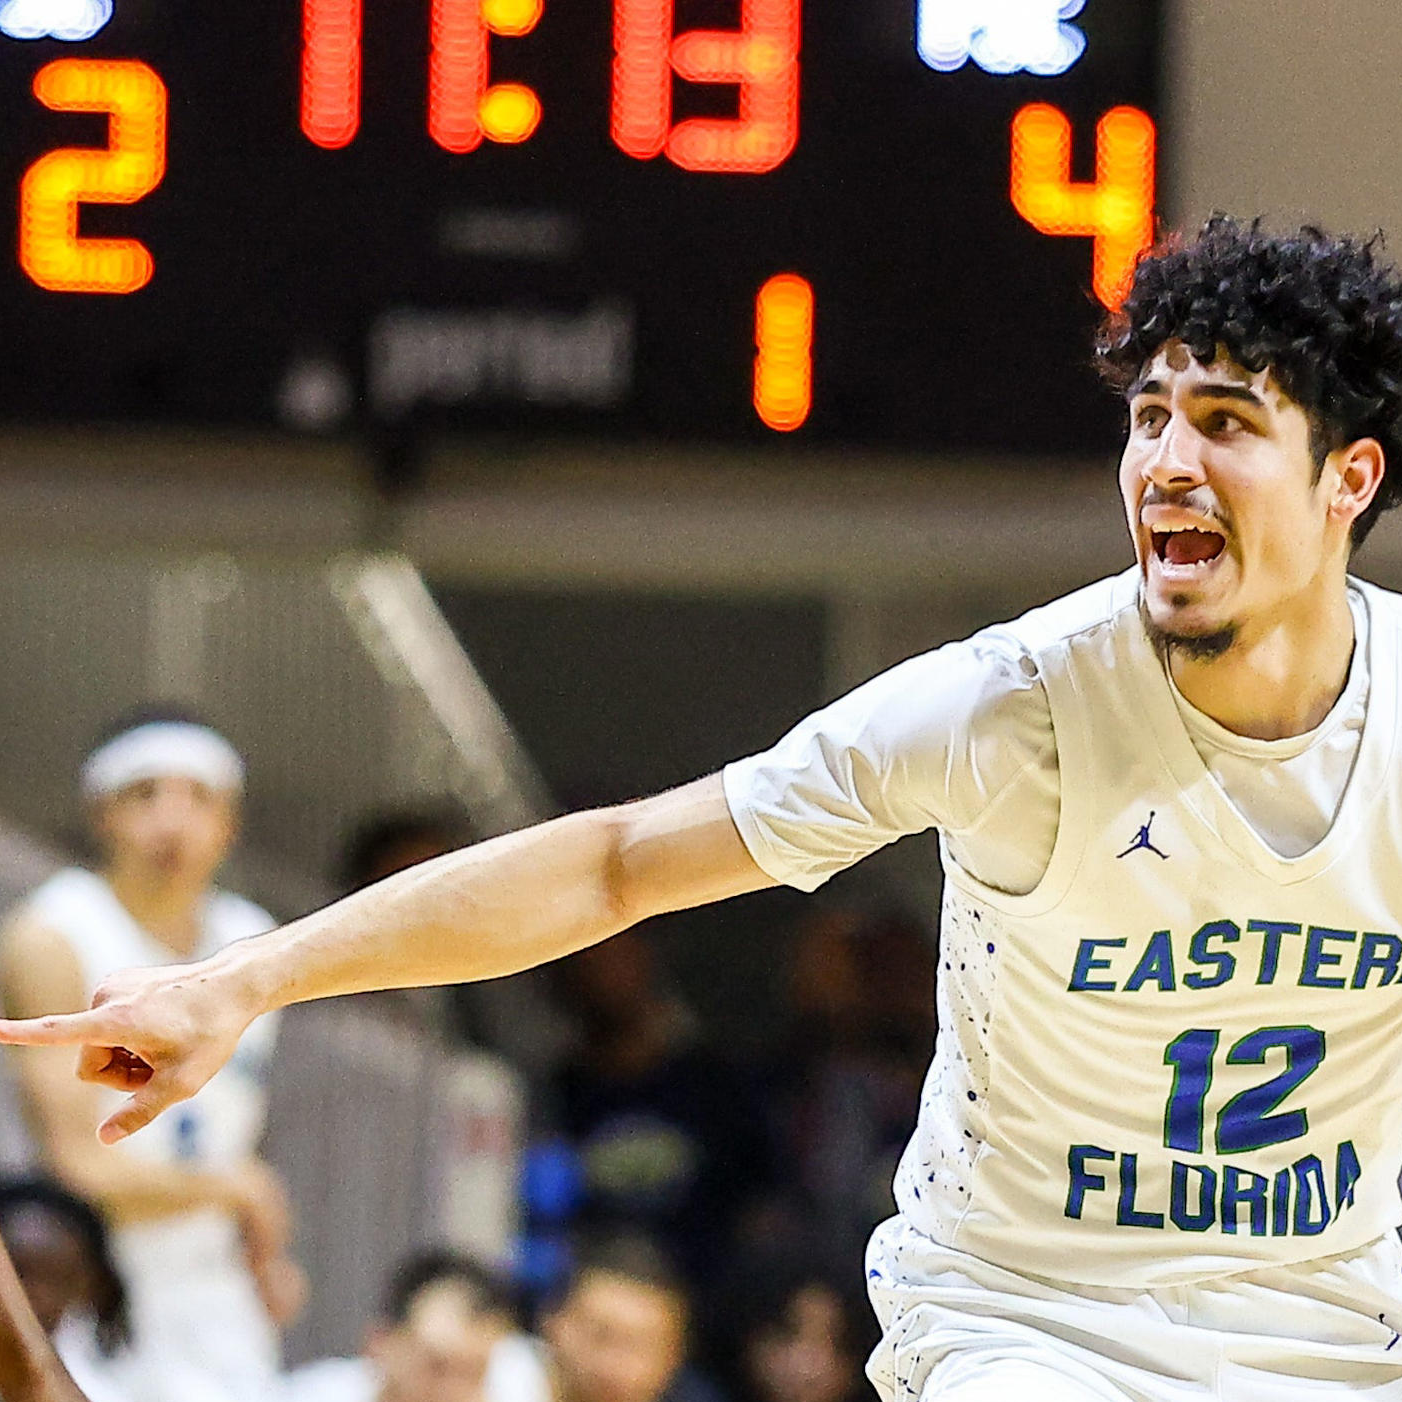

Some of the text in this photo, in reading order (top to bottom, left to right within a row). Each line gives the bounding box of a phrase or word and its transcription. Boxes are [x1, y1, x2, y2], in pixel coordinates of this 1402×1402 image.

[20, 59, 165, 291] 2
[1011, 102, 1154, 314] 4
[754, 275, 812, 431] 1
[1163, 1024, 1326, 1156] 12
[1064, 1140, 1362, 1237] FLORIDA
